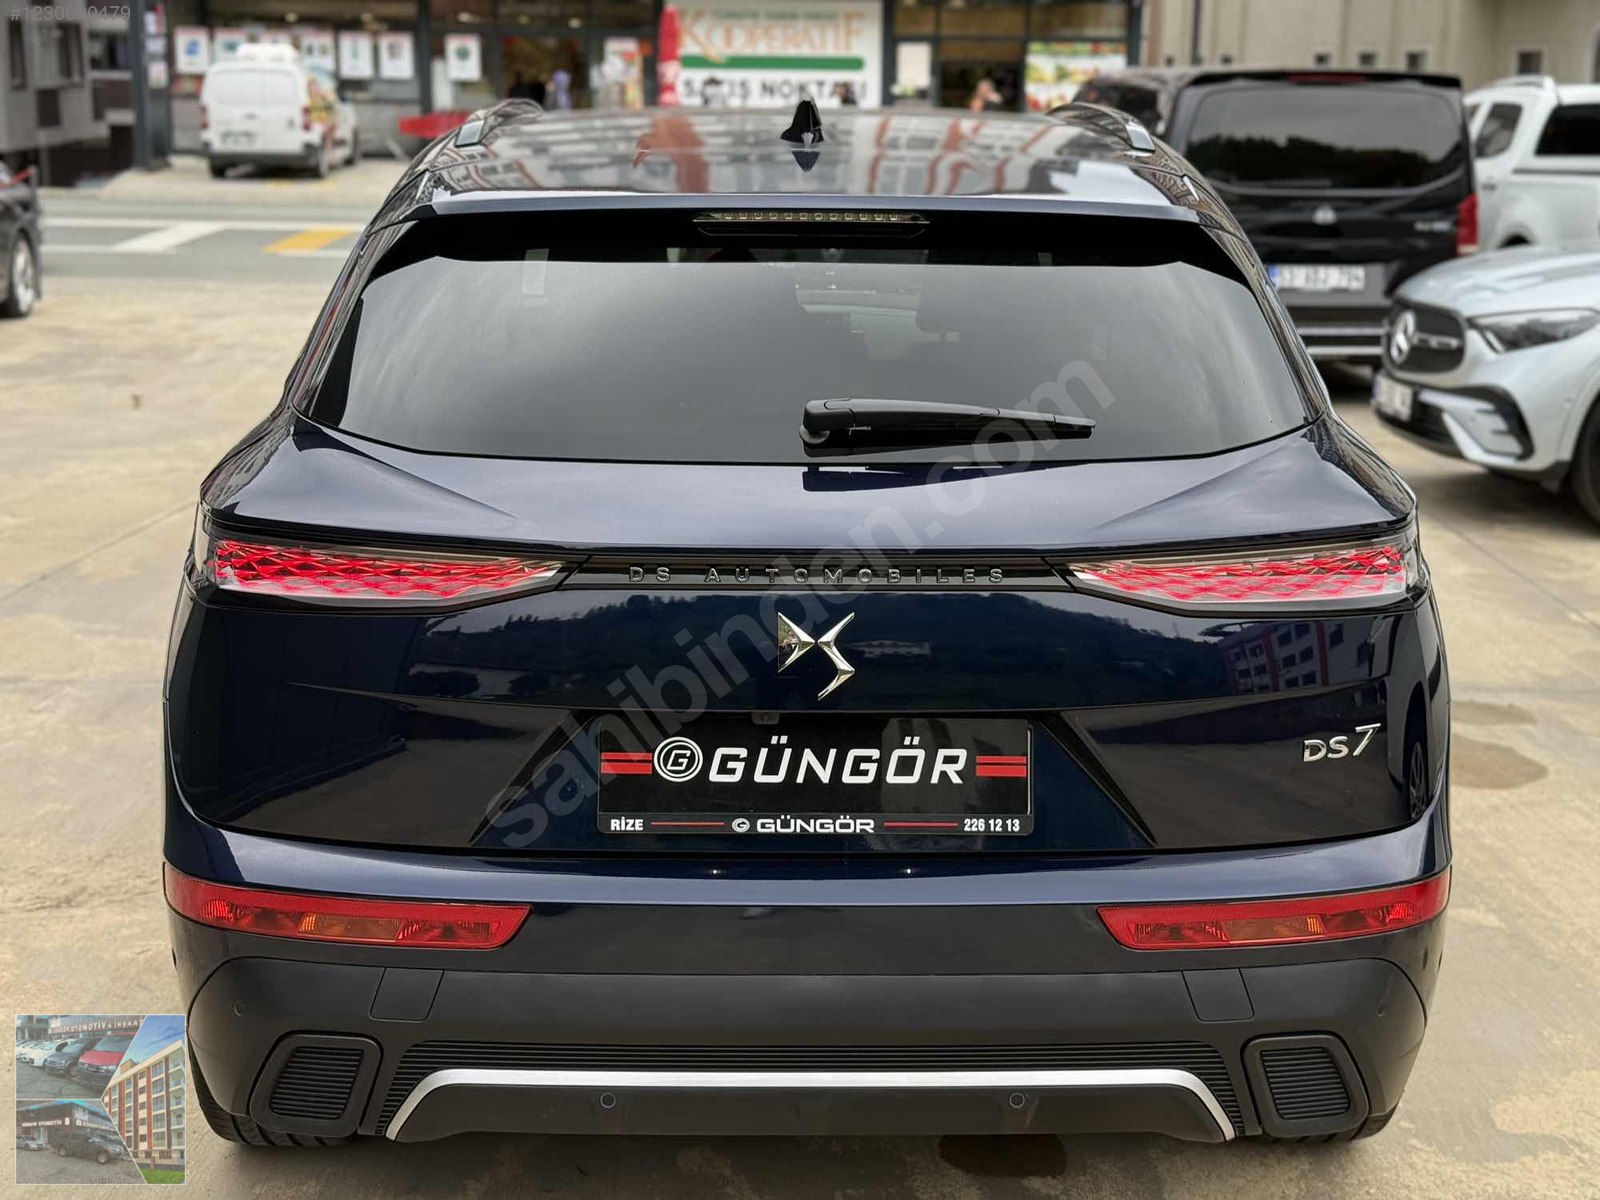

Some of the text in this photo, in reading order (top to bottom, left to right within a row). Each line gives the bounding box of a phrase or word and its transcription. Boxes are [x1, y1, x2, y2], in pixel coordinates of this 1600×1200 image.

[628, 566, 1005, 584] DS AUTOMOBILES
[708, 735, 968, 784] GÜNGÖR
[610, 816, 644, 831] RİZE
[756, 815, 875, 834] GÜNGÖR
[963, 818, 985, 832] 226
[988, 818, 1003, 832] 12
